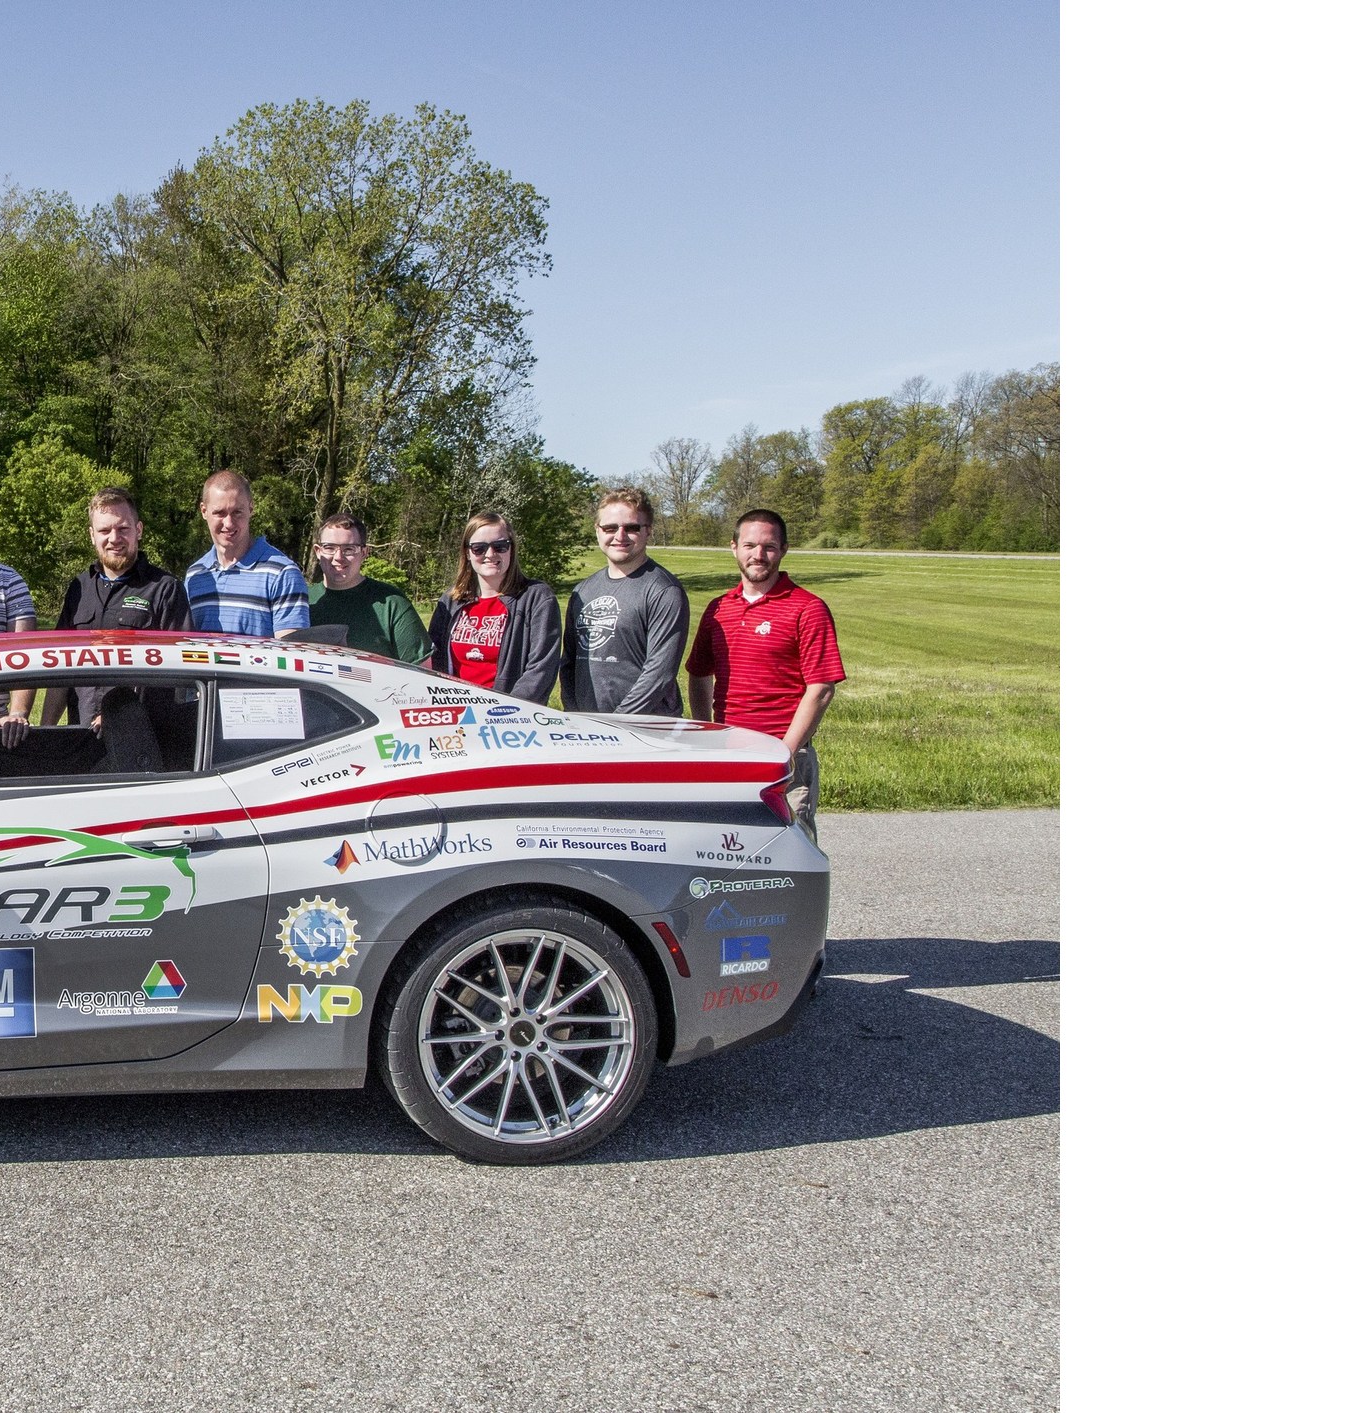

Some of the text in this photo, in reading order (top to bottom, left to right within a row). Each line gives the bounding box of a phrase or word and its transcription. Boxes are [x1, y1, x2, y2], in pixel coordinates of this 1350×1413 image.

[41, 648, 133, 668] STATE
[144, 648, 164, 666] 8
[426, 686, 471, 695] Mentor
[431, 695, 500, 706] Automotive
[405, 710, 453, 726] tesa
[489, 706, 518, 714] SAMSUNG
[430, 735, 464, 751] A123
[478, 725, 543, 750] flex
[550, 733, 620, 743] DELPHI
[319, 751, 341, 762] RESEARCH
[430, 750, 468, 760] SYSTEMS
[271, 757, 314, 776] EPRI
[301, 769, 350, 787] VECTOR
[552, 825, 600, 833] Environmental
[602, 826, 637, 835] Protection
[639, 827, 664, 836] Agency
[363, 833, 493, 862] MathWorks
[538, 838, 667, 853] Air Resources Board
[696, 851, 772, 865] WOODWARD
[709, 877, 795, 893] PROTERRA
[292, 926, 345, 948] NSF
[722, 961, 768, 976] RICARDO
[57, 988, 146, 1014] Argonne
[257, 984, 363, 1024] NXP
[701, 981, 780, 1012] DENSO
[96, 1006, 179, 1016] NATIONAL LABORATORY
